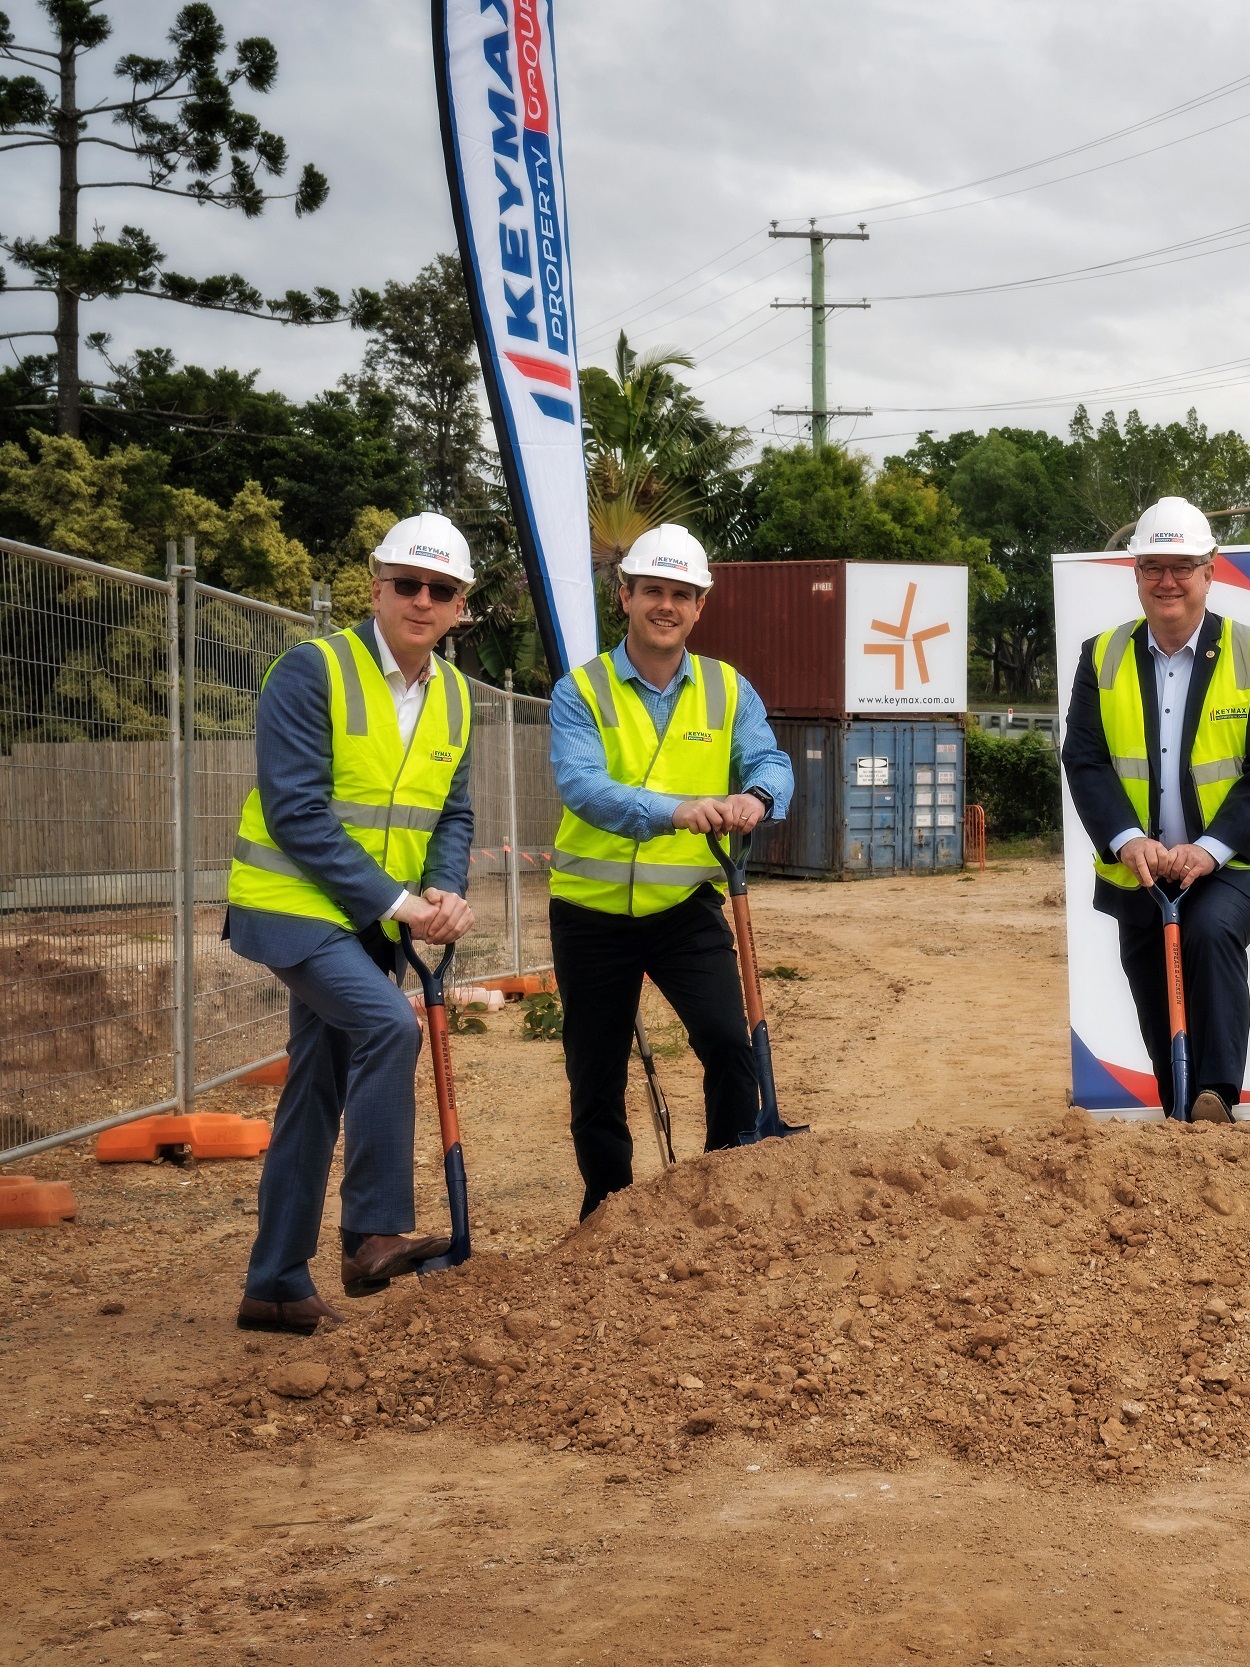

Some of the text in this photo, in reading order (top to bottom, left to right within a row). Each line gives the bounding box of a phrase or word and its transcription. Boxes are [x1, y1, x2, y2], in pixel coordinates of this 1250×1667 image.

[530, 146, 564, 342] PROPERTY
[416, 544, 450, 558] KEYMAX
[658, 556, 689, 567] KEYMAX
[858, 695, 955, 706] www.keymax.com.au
[1215, 707, 1247, 715] KEYMAX
[440, 1036, 449, 1063] SPEAR
[445, 1072, 455, 1110] JACKSON
